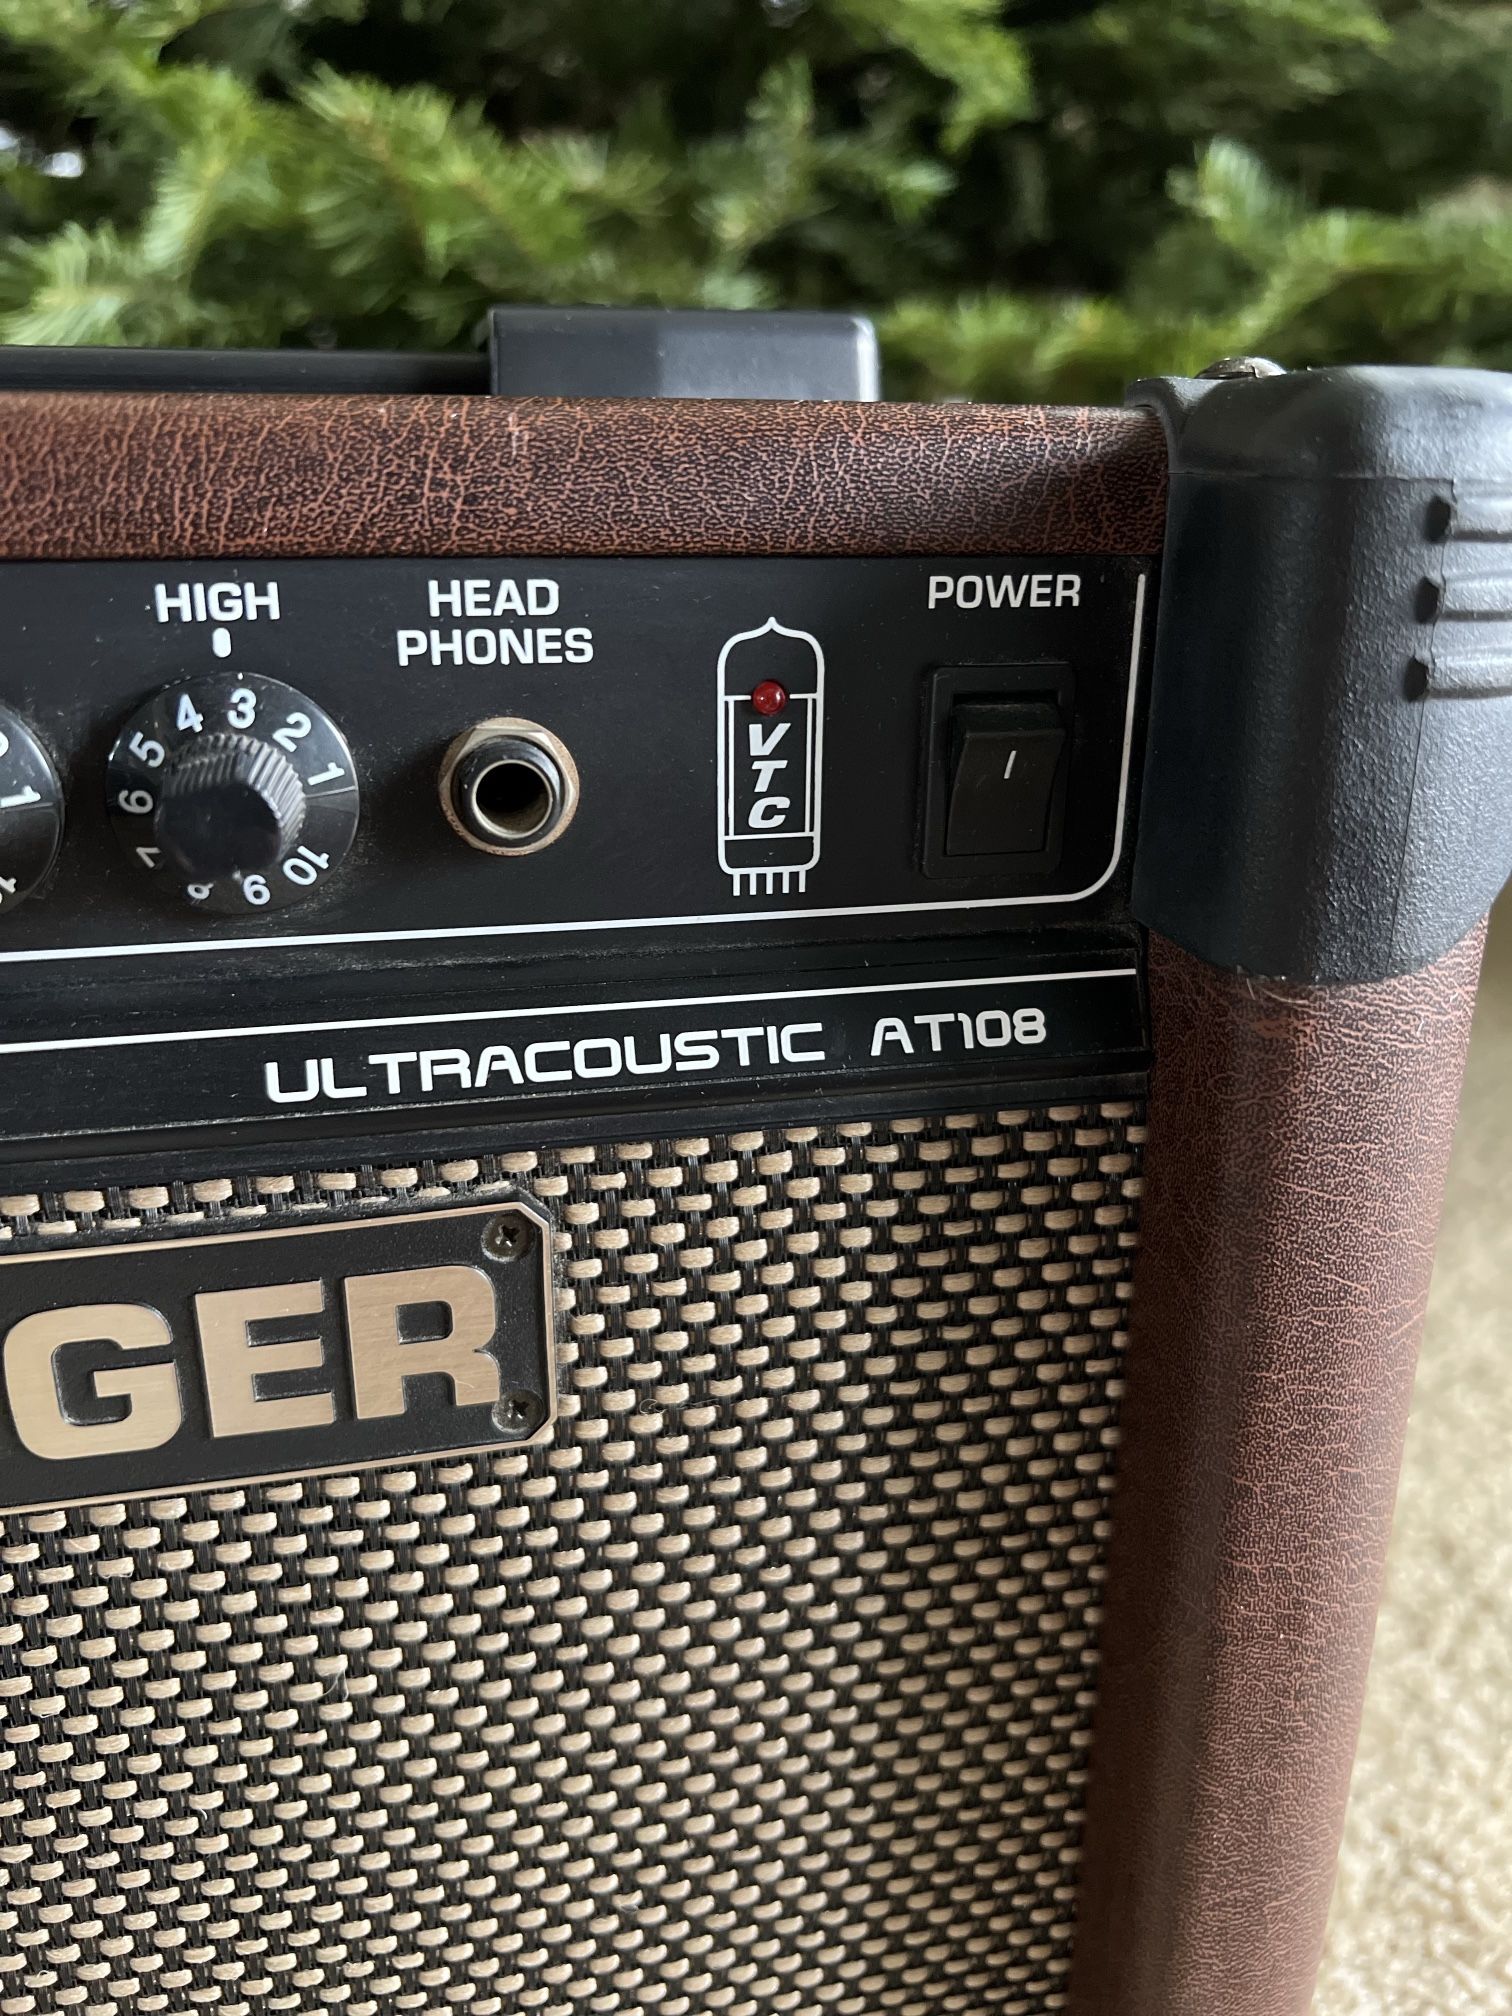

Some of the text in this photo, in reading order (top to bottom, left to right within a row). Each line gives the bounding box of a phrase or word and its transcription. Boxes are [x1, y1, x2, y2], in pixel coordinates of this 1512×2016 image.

[154, 581, 281, 622] HIGH
[428, 578, 560, 617] HEAD
[929, 575, 1081, 609] POWER
[397, 627, 594, 666] PHONES
[176, 694, 204, 733] 4
[227, 688, 257, 729] 3
[129, 731, 165, 768] 5
[272, 712, 312, 753] 2
[307, 762, 345, 786] 1
[118, 790, 153, 814] 6
[282, 846, 330, 886] 10
[243, 875, 271, 905] 9
[265, 1007, 1047, 1103] ULTRACOUSTIC AT108
[3, 1265, 501, 1461] GER
